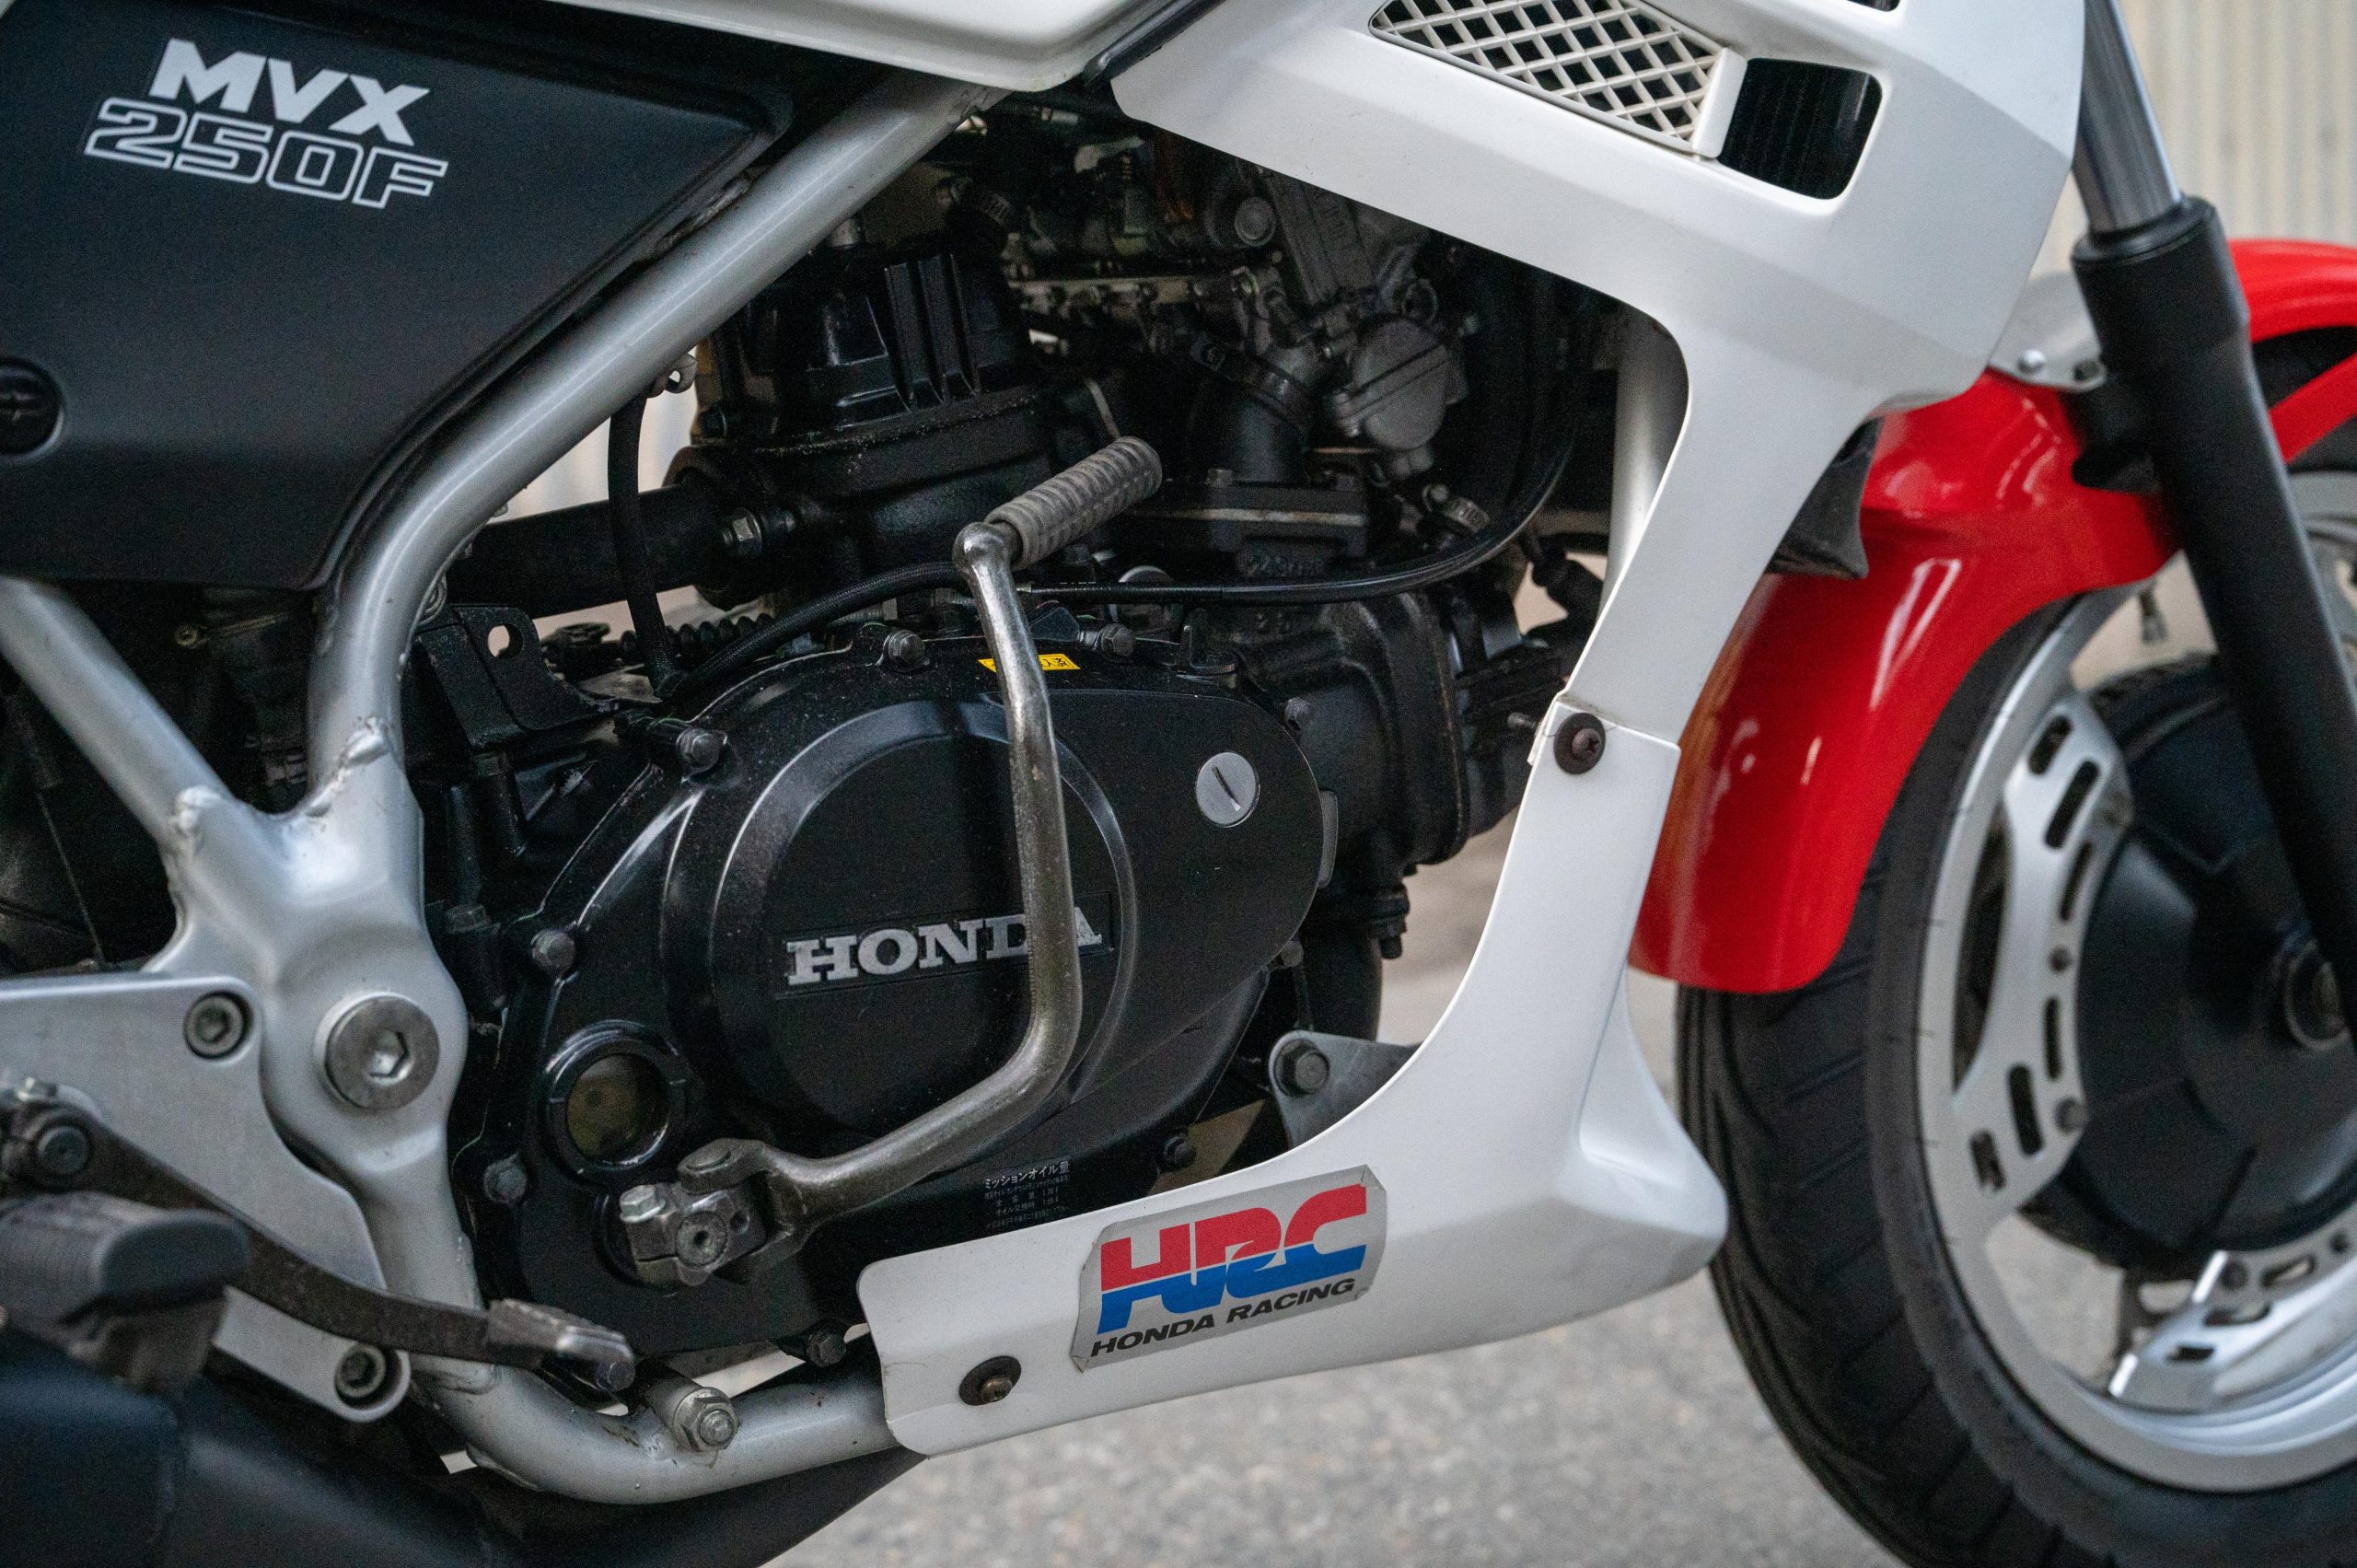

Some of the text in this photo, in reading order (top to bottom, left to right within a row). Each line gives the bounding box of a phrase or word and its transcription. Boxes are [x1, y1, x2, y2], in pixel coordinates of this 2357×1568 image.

[149, 39, 430, 146] MVX
[84, 97, 448, 209] 250F
[984, 1160, 1071, 1190] ミッションオイル量
[1097, 1183, 1367, 1335] HRC
[1090, 1278, 1356, 1358] HONDA RACING
